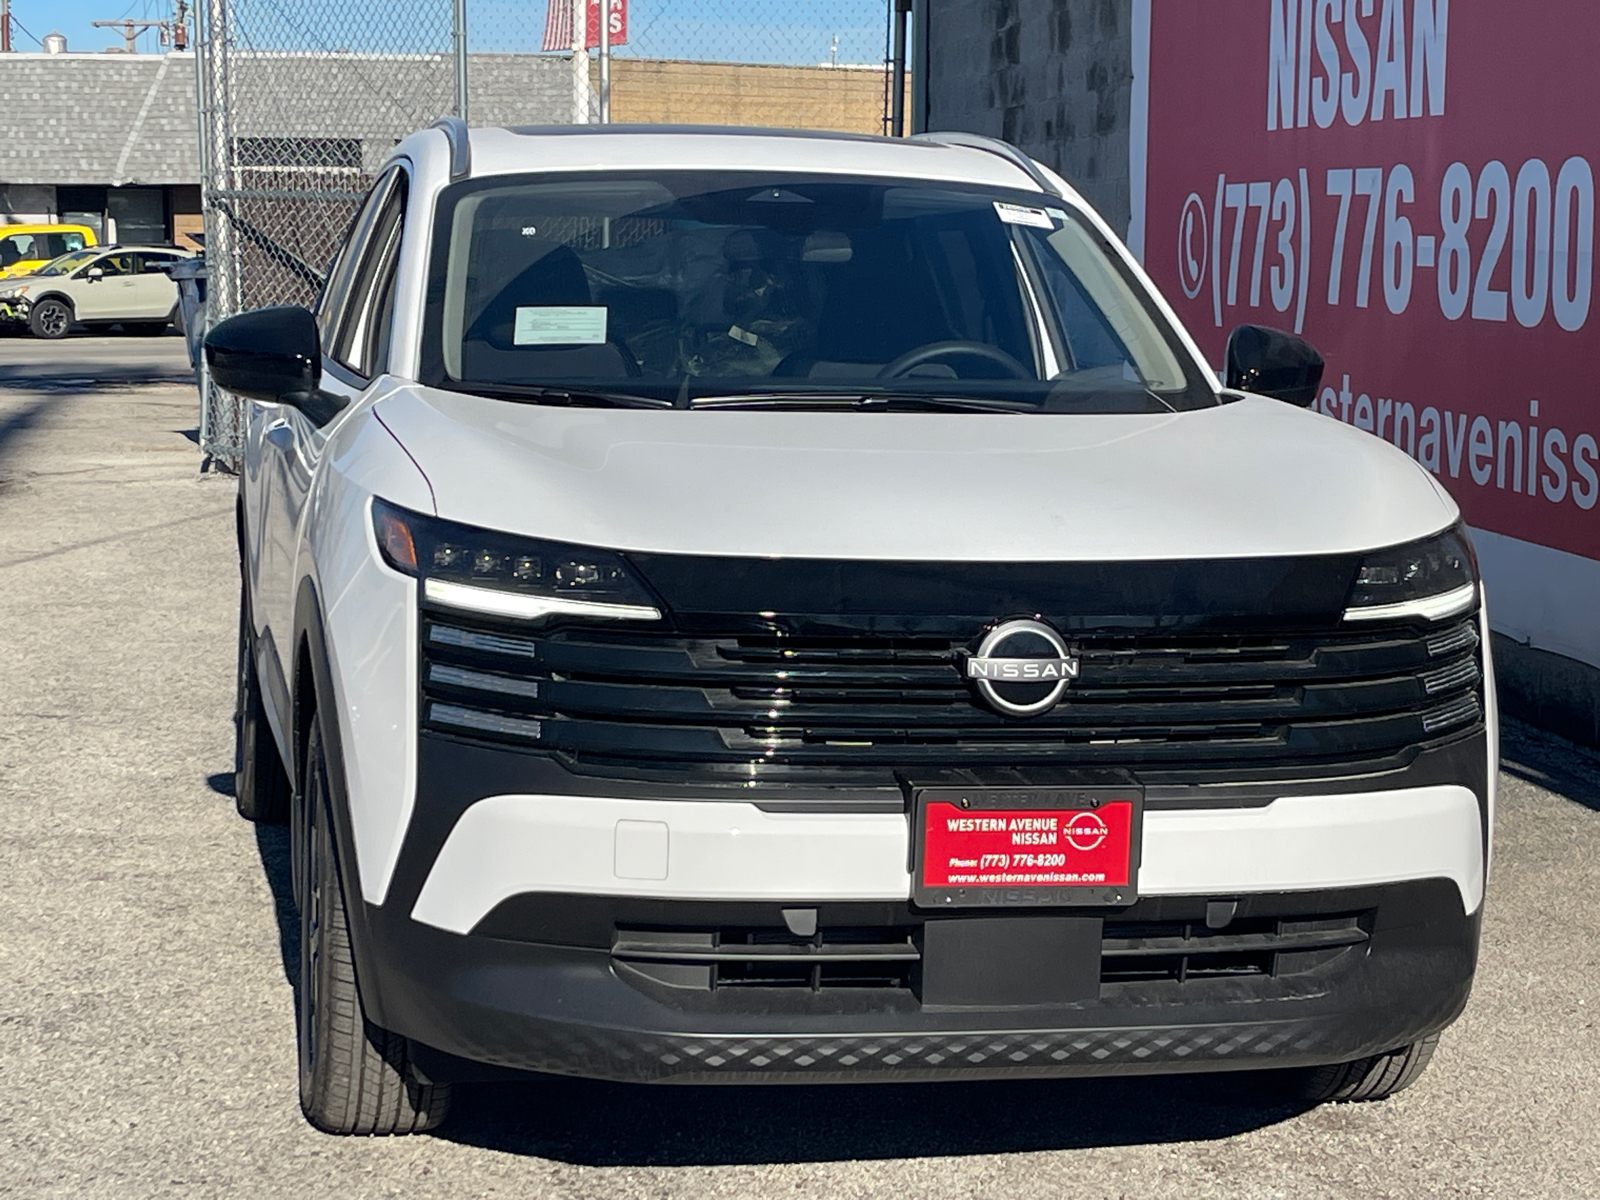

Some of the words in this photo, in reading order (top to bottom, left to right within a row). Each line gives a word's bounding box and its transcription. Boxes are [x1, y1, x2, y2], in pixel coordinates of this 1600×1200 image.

[1267, 0, 1448, 131] NISSAN
[1212, 168, 1310, 334] (773)
[1326, 156, 1594, 331] 776-8200
[1309, 374, 1599, 510] sternaveniss
[970, 661, 1077, 678] NISSAN
[947, 819, 1006, 832] WESTERN
[1008, 818, 1058, 831] AVENUE
[1063, 827, 1108, 836] NISSAN
[1012, 832, 1057, 845] NISSAN
[980, 854, 1010, 869] (773)
[1012, 853, 1066, 867] 776-8200
[948, 872, 1105, 883] www.westernavenissan.com
